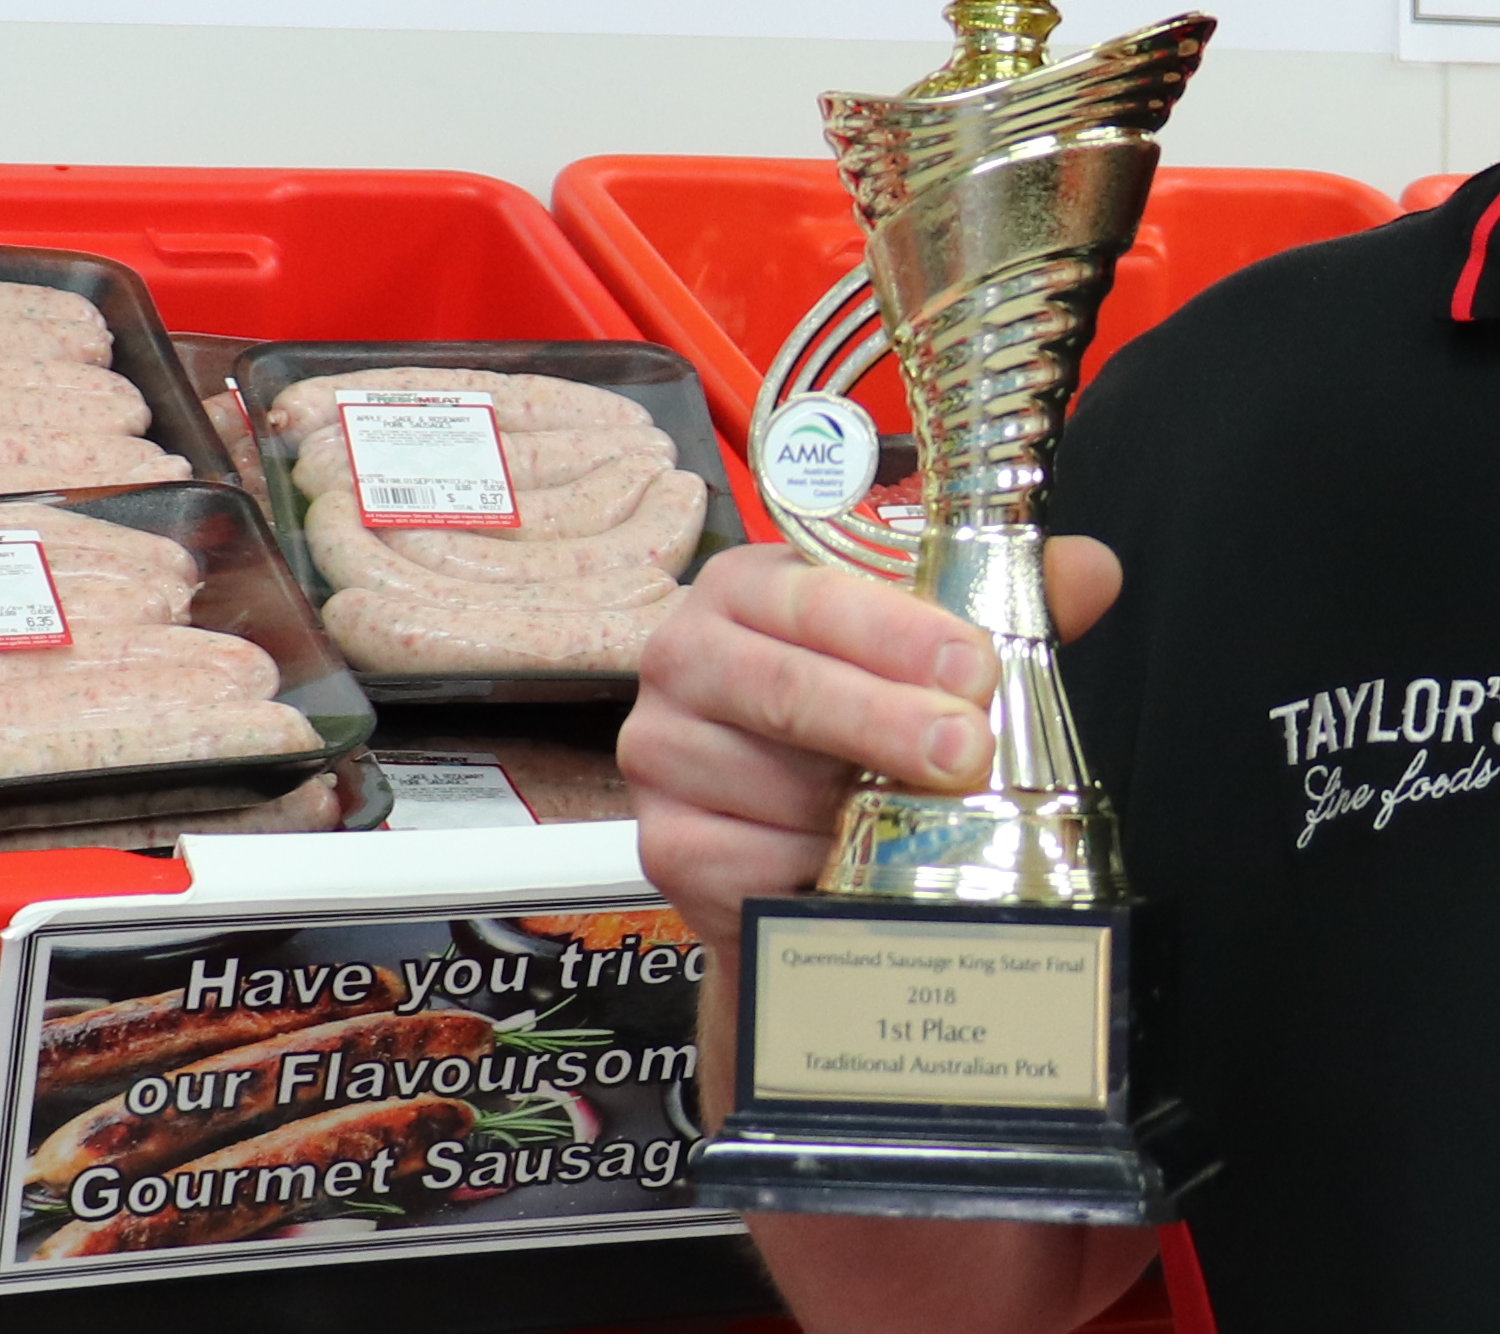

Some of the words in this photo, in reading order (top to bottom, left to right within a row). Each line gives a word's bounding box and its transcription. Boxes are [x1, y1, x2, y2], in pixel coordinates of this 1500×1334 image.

[777, 443, 844, 465] AMIC
[782, 948, 882, 968] Queensland
[887, 950, 954, 975] Sausage
[958, 955, 995, 976] King
[1002, 956, 1041, 972] State
[1045, 955, 1085, 974] Final
[184, 956, 375, 1012] Have
[396, 951, 529, 1015] you
[907, 986, 958, 1005] 2018
[876, 1018, 912, 1041] 1st
[921, 1016, 987, 1044] Place
[805, 1052, 905, 1074] Traditional
[910, 1054, 1009, 1077] Australian
[1015, 1057, 1059, 1078] Pork
[124, 1072, 252, 1116] our
[276, 1043, 701, 1106] Flavoursom
[68, 1155, 396, 1222] Gourmet
[422, 1135, 703, 1189] Sausag
